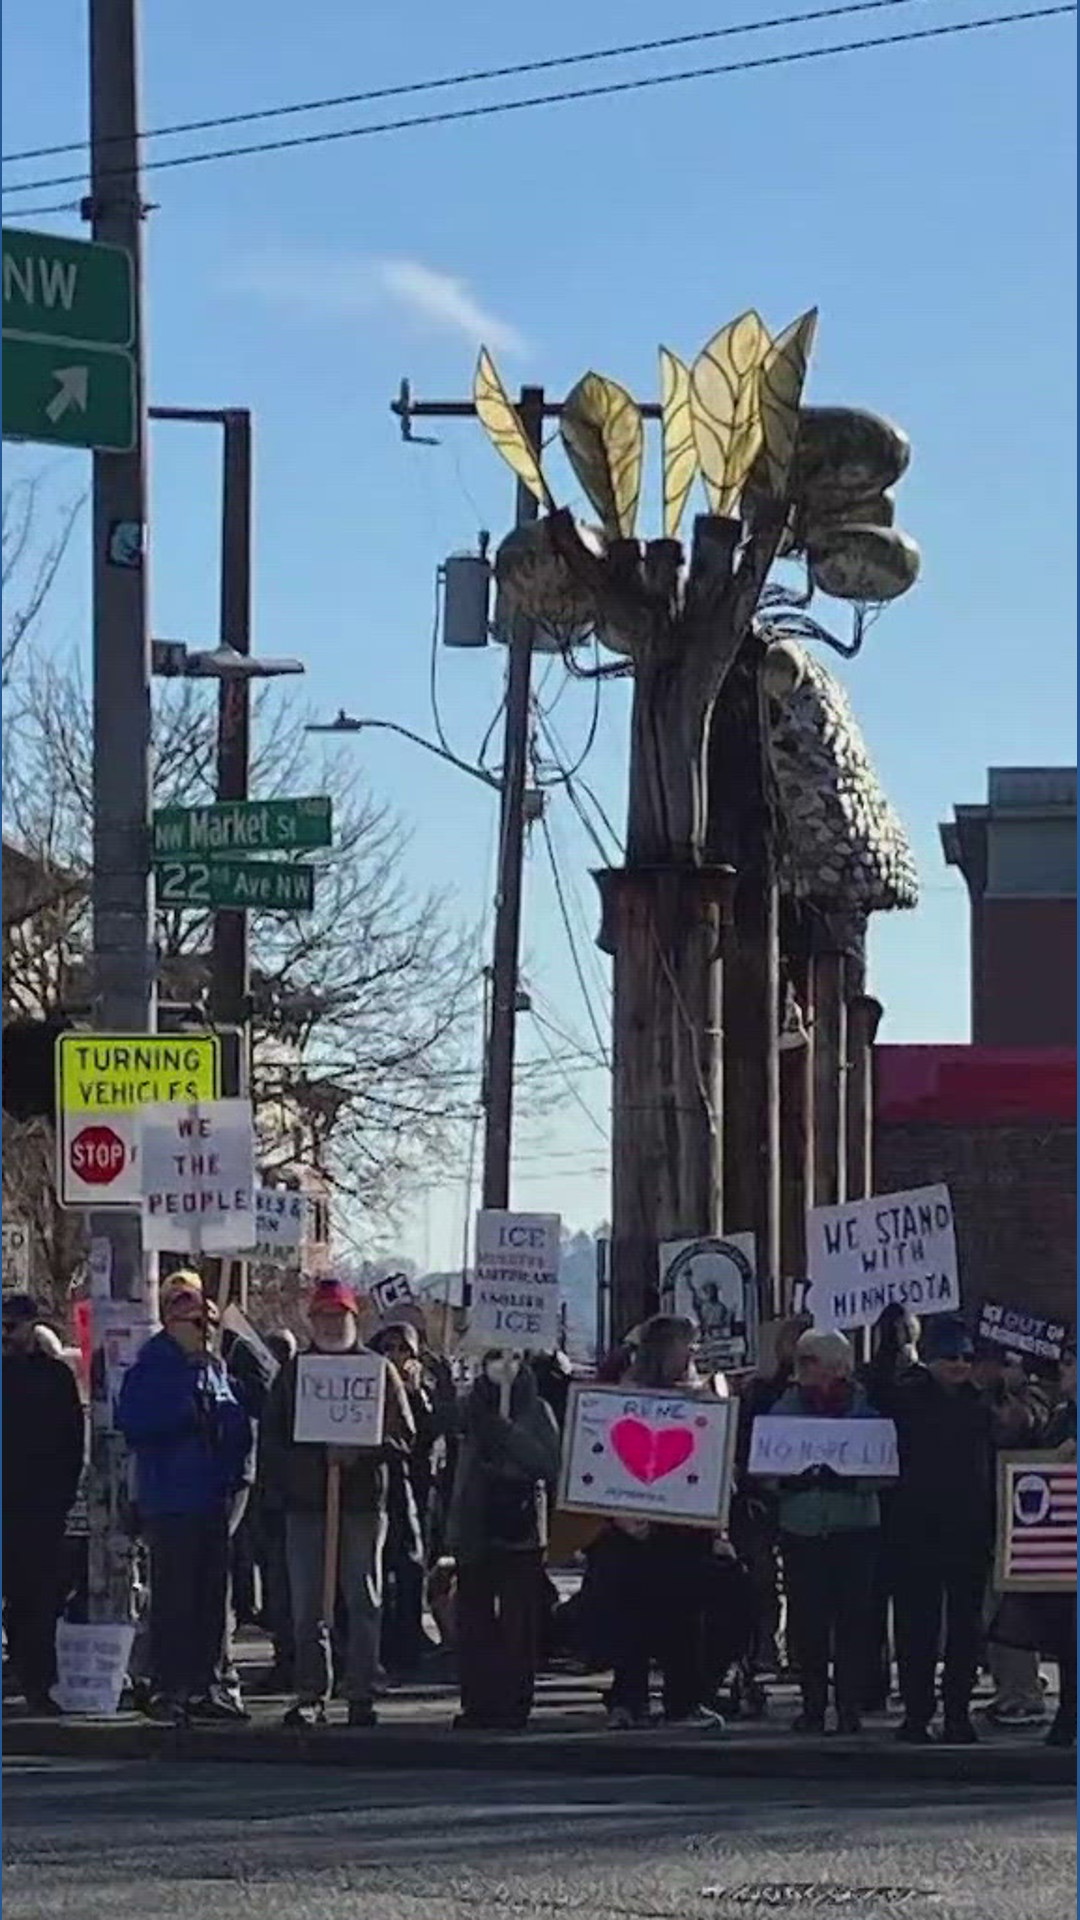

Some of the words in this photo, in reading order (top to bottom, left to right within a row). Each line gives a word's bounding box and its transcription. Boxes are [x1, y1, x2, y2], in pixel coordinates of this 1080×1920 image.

[3, 252, 77, 311] NW
[155, 824, 182, 850] NW
[190, 808, 270, 849] Market
[277, 815, 296, 840] St
[234, 871, 272, 897] Ave
[277, 874, 309, 899] NW
[75, 1046, 201, 1072] TURNING
[78, 1081, 199, 1106] VEHICLES
[177, 1118, 212, 1139] WE
[72, 1145, 124, 1167] STOP
[172, 1155, 219, 1176] THE
[148, 1189, 248, 1216] PEOPLE
[498, 1226, 546, 1249] ICE
[824, 1216, 859, 1255] WE
[876, 1203, 950, 1244] STAND
[862, 1238, 925, 1273] WITH
[373, 1275, 412, 1313] ICE
[833, 1273, 952, 1318] MINNESOTA
[494, 1311, 541, 1334] ICE
